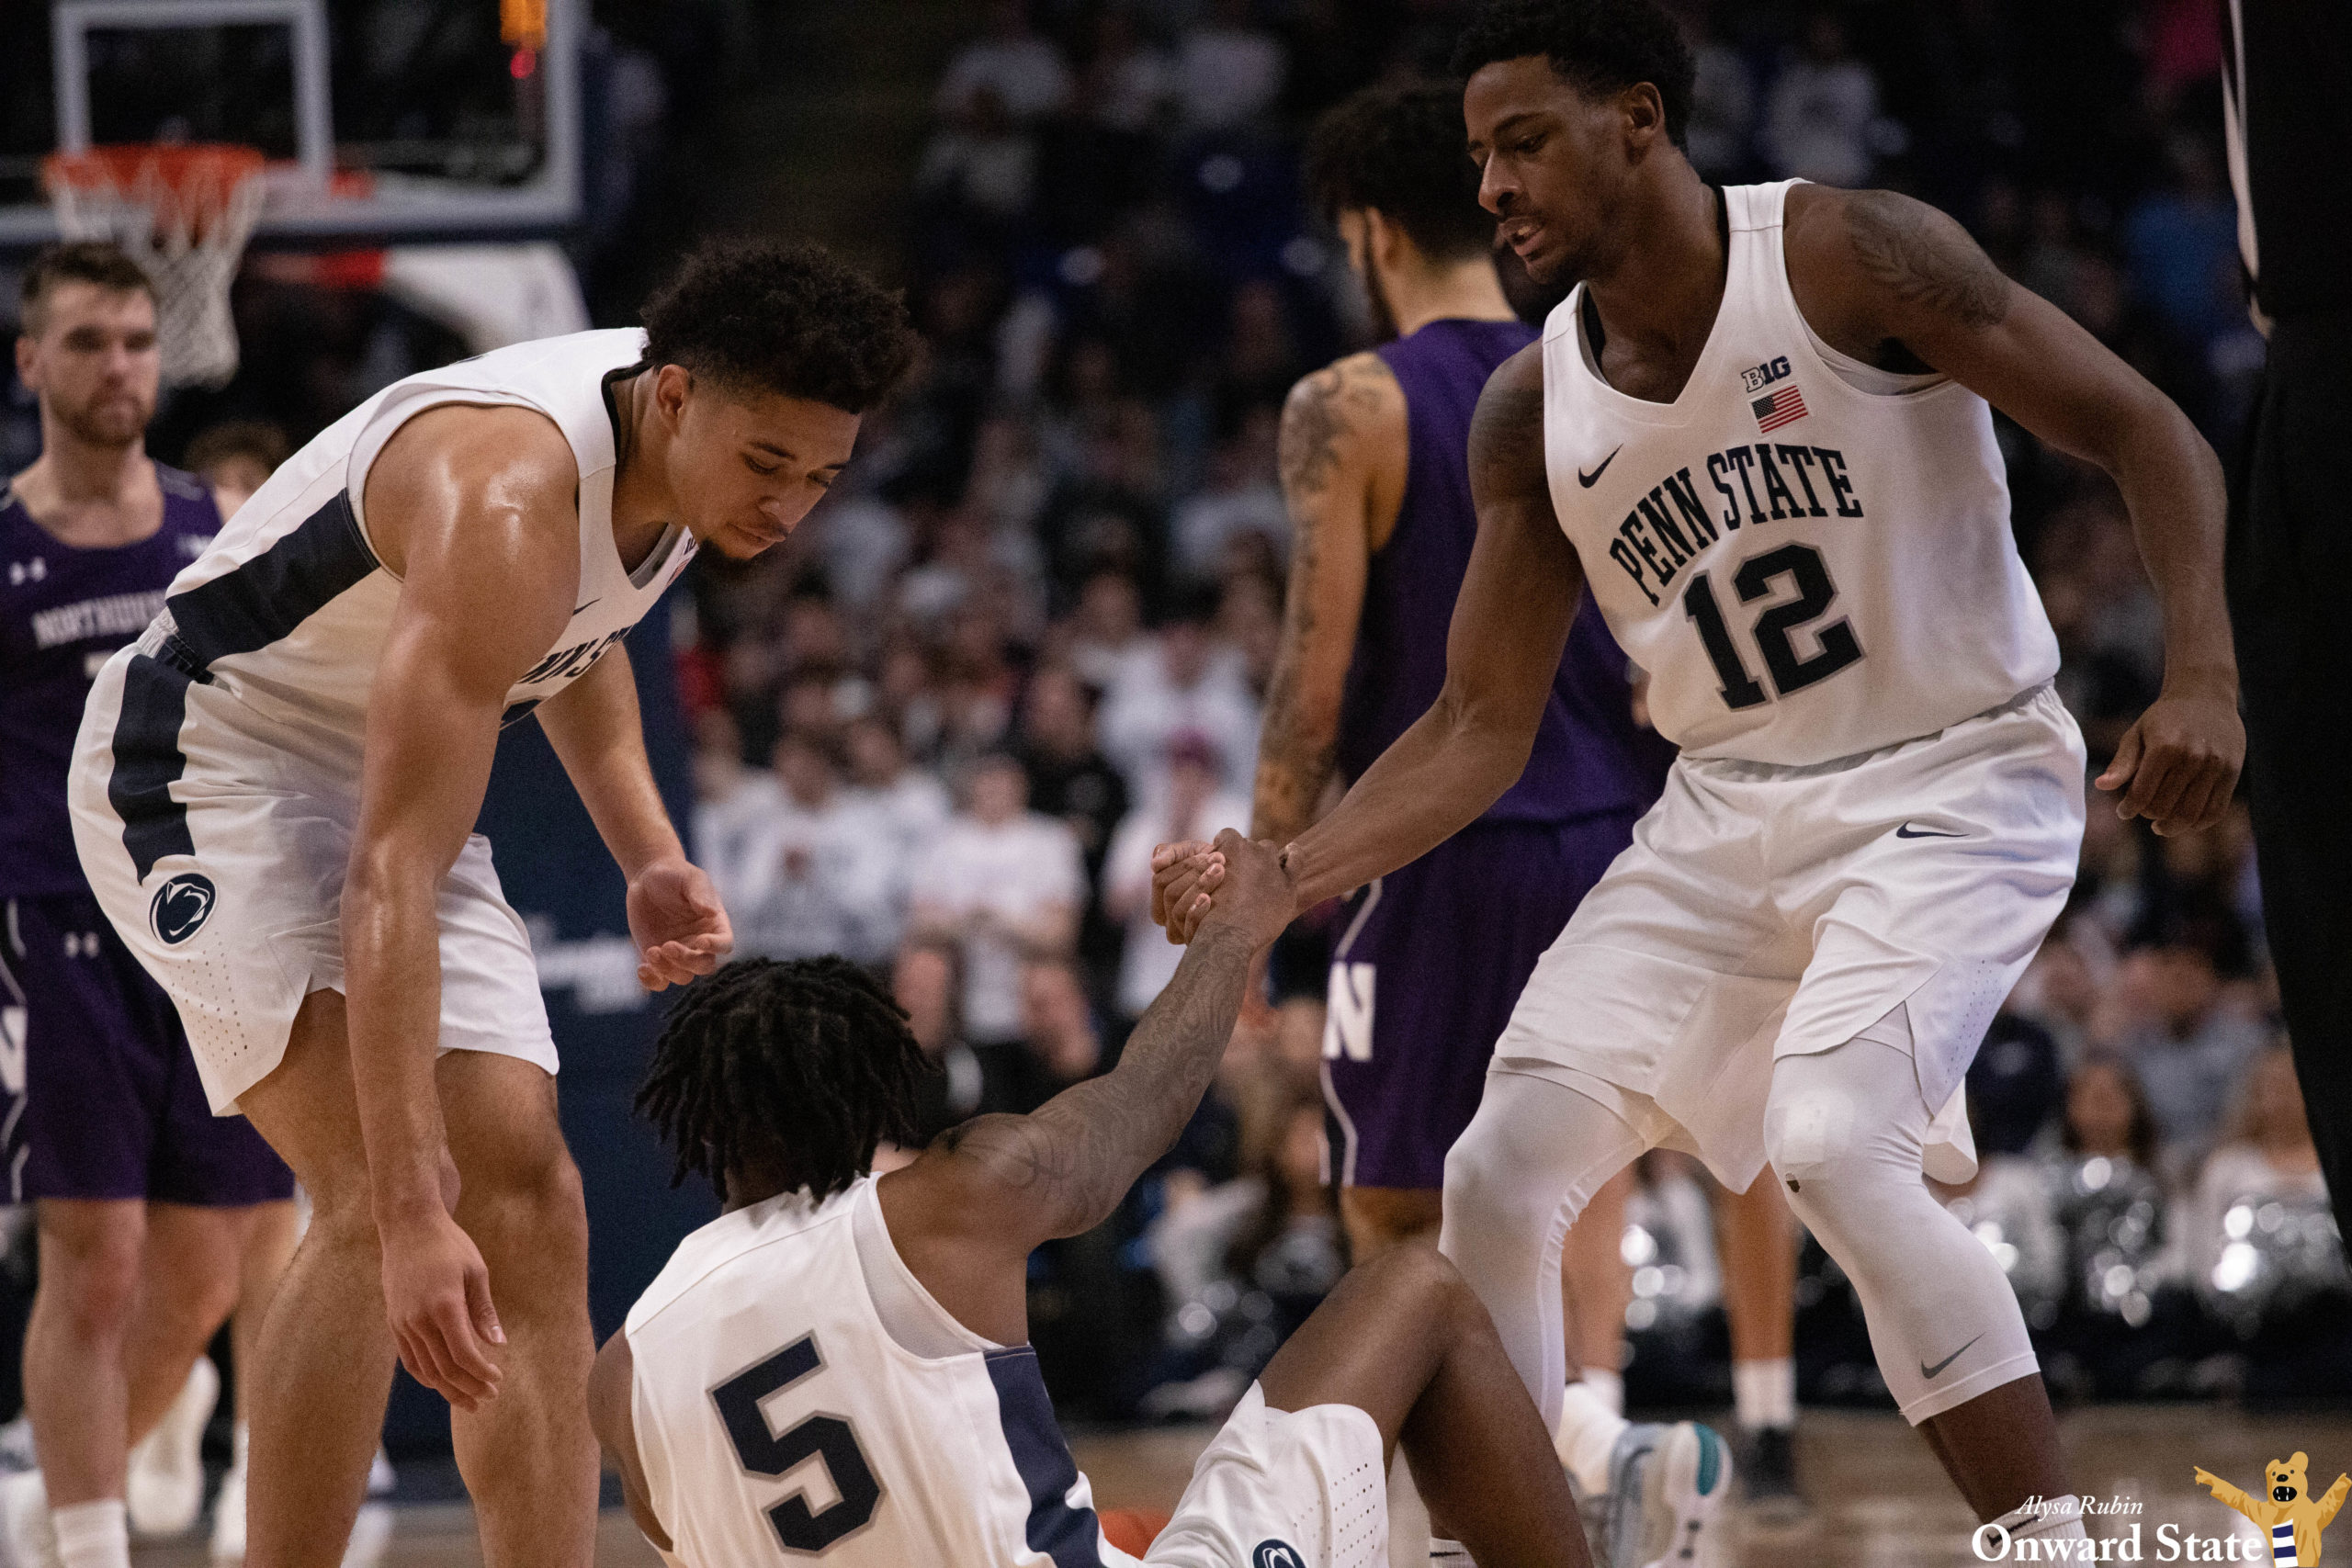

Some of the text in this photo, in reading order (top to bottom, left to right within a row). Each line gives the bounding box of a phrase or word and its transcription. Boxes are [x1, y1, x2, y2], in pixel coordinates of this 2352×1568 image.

[1610, 443, 1864, 607] PENN STATE
[1681, 540, 1867, 712] 12
[1320, 961, 1376, 1062] N
[705, 1328, 889, 1559] 5
